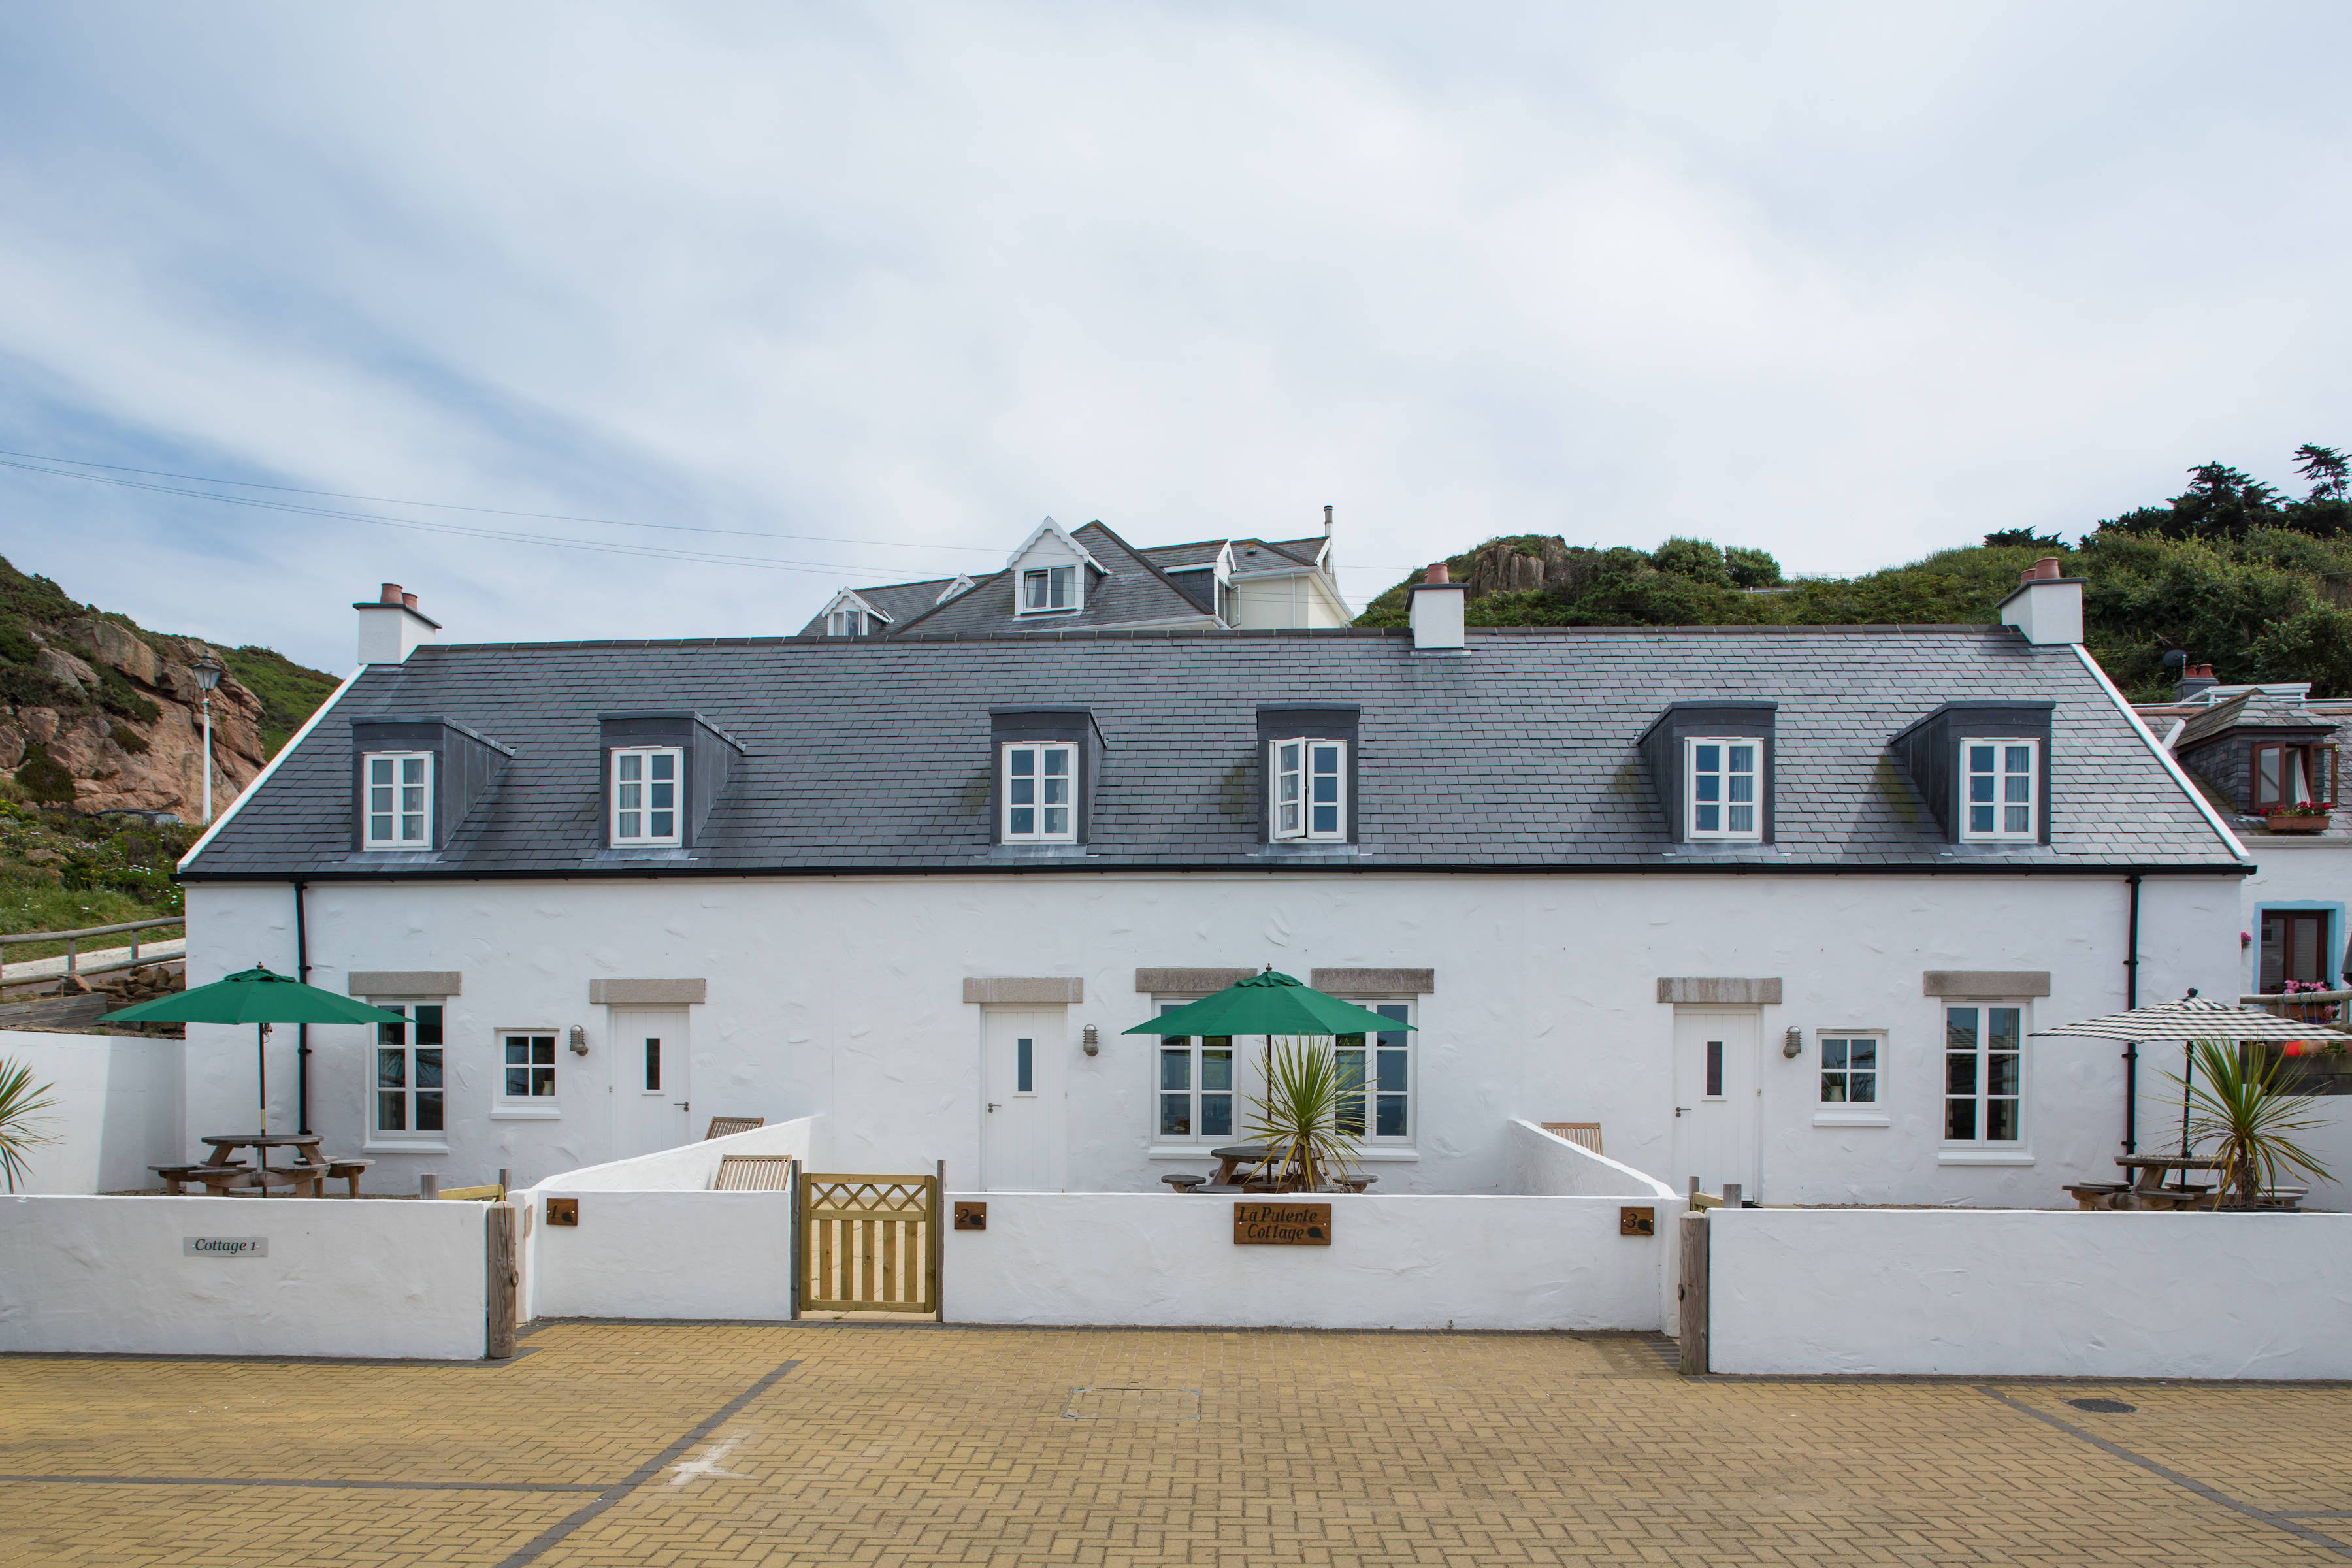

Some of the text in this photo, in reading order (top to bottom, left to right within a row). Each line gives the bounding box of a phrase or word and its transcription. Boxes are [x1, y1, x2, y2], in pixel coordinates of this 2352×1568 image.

[551, 1205, 557, 1218] 1
[958, 1209, 969, 1222] 2
[1239, 1207, 1318, 1223] La Pulente
[1626, 1213, 1637, 1228] 3
[1247, 1223, 1305, 1243] Cottage
[195, 1239, 257, 1254] Cottage 1
